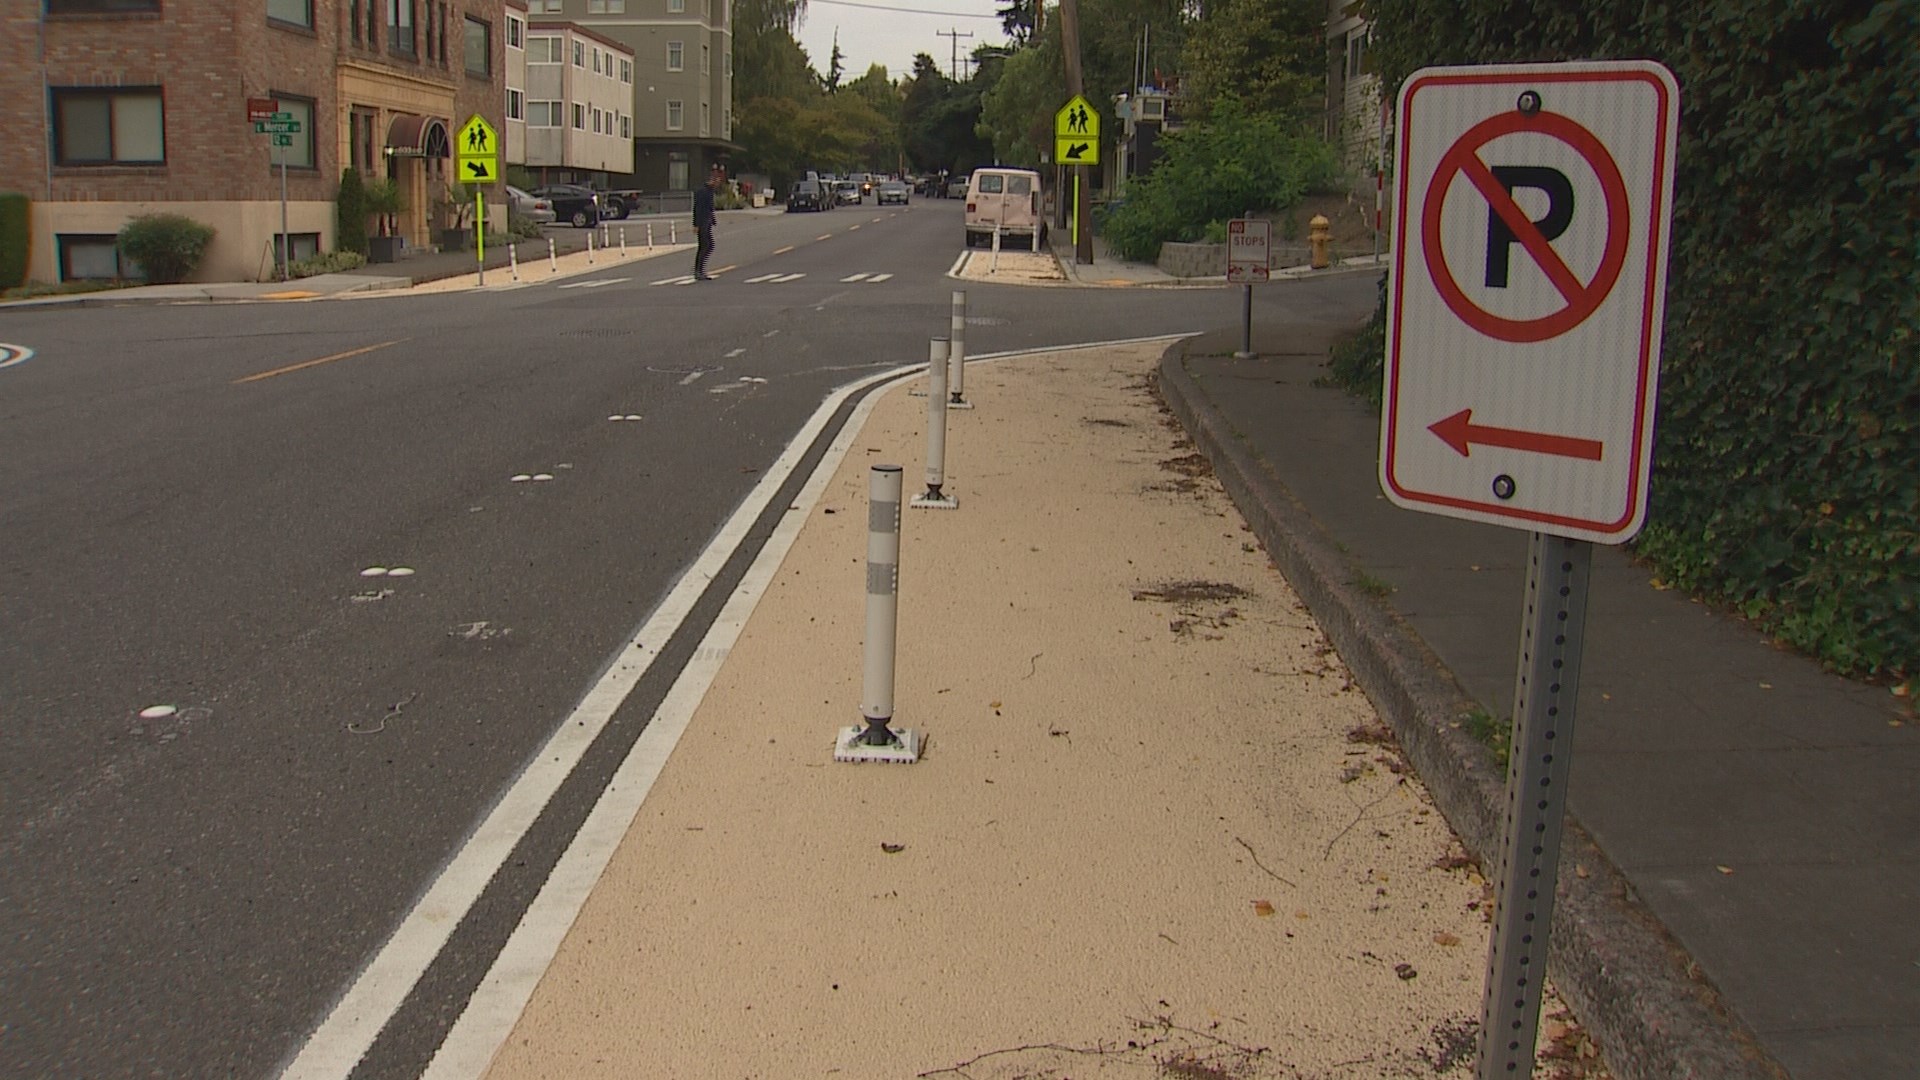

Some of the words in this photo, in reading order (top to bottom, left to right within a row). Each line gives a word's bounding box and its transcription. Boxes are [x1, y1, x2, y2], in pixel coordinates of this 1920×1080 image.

[264, 121, 289, 132] Mercer
[1231, 222, 1243, 231] NO
[1485, 166, 1575, 288] P
[1233, 236, 1265, 246] STOPS
